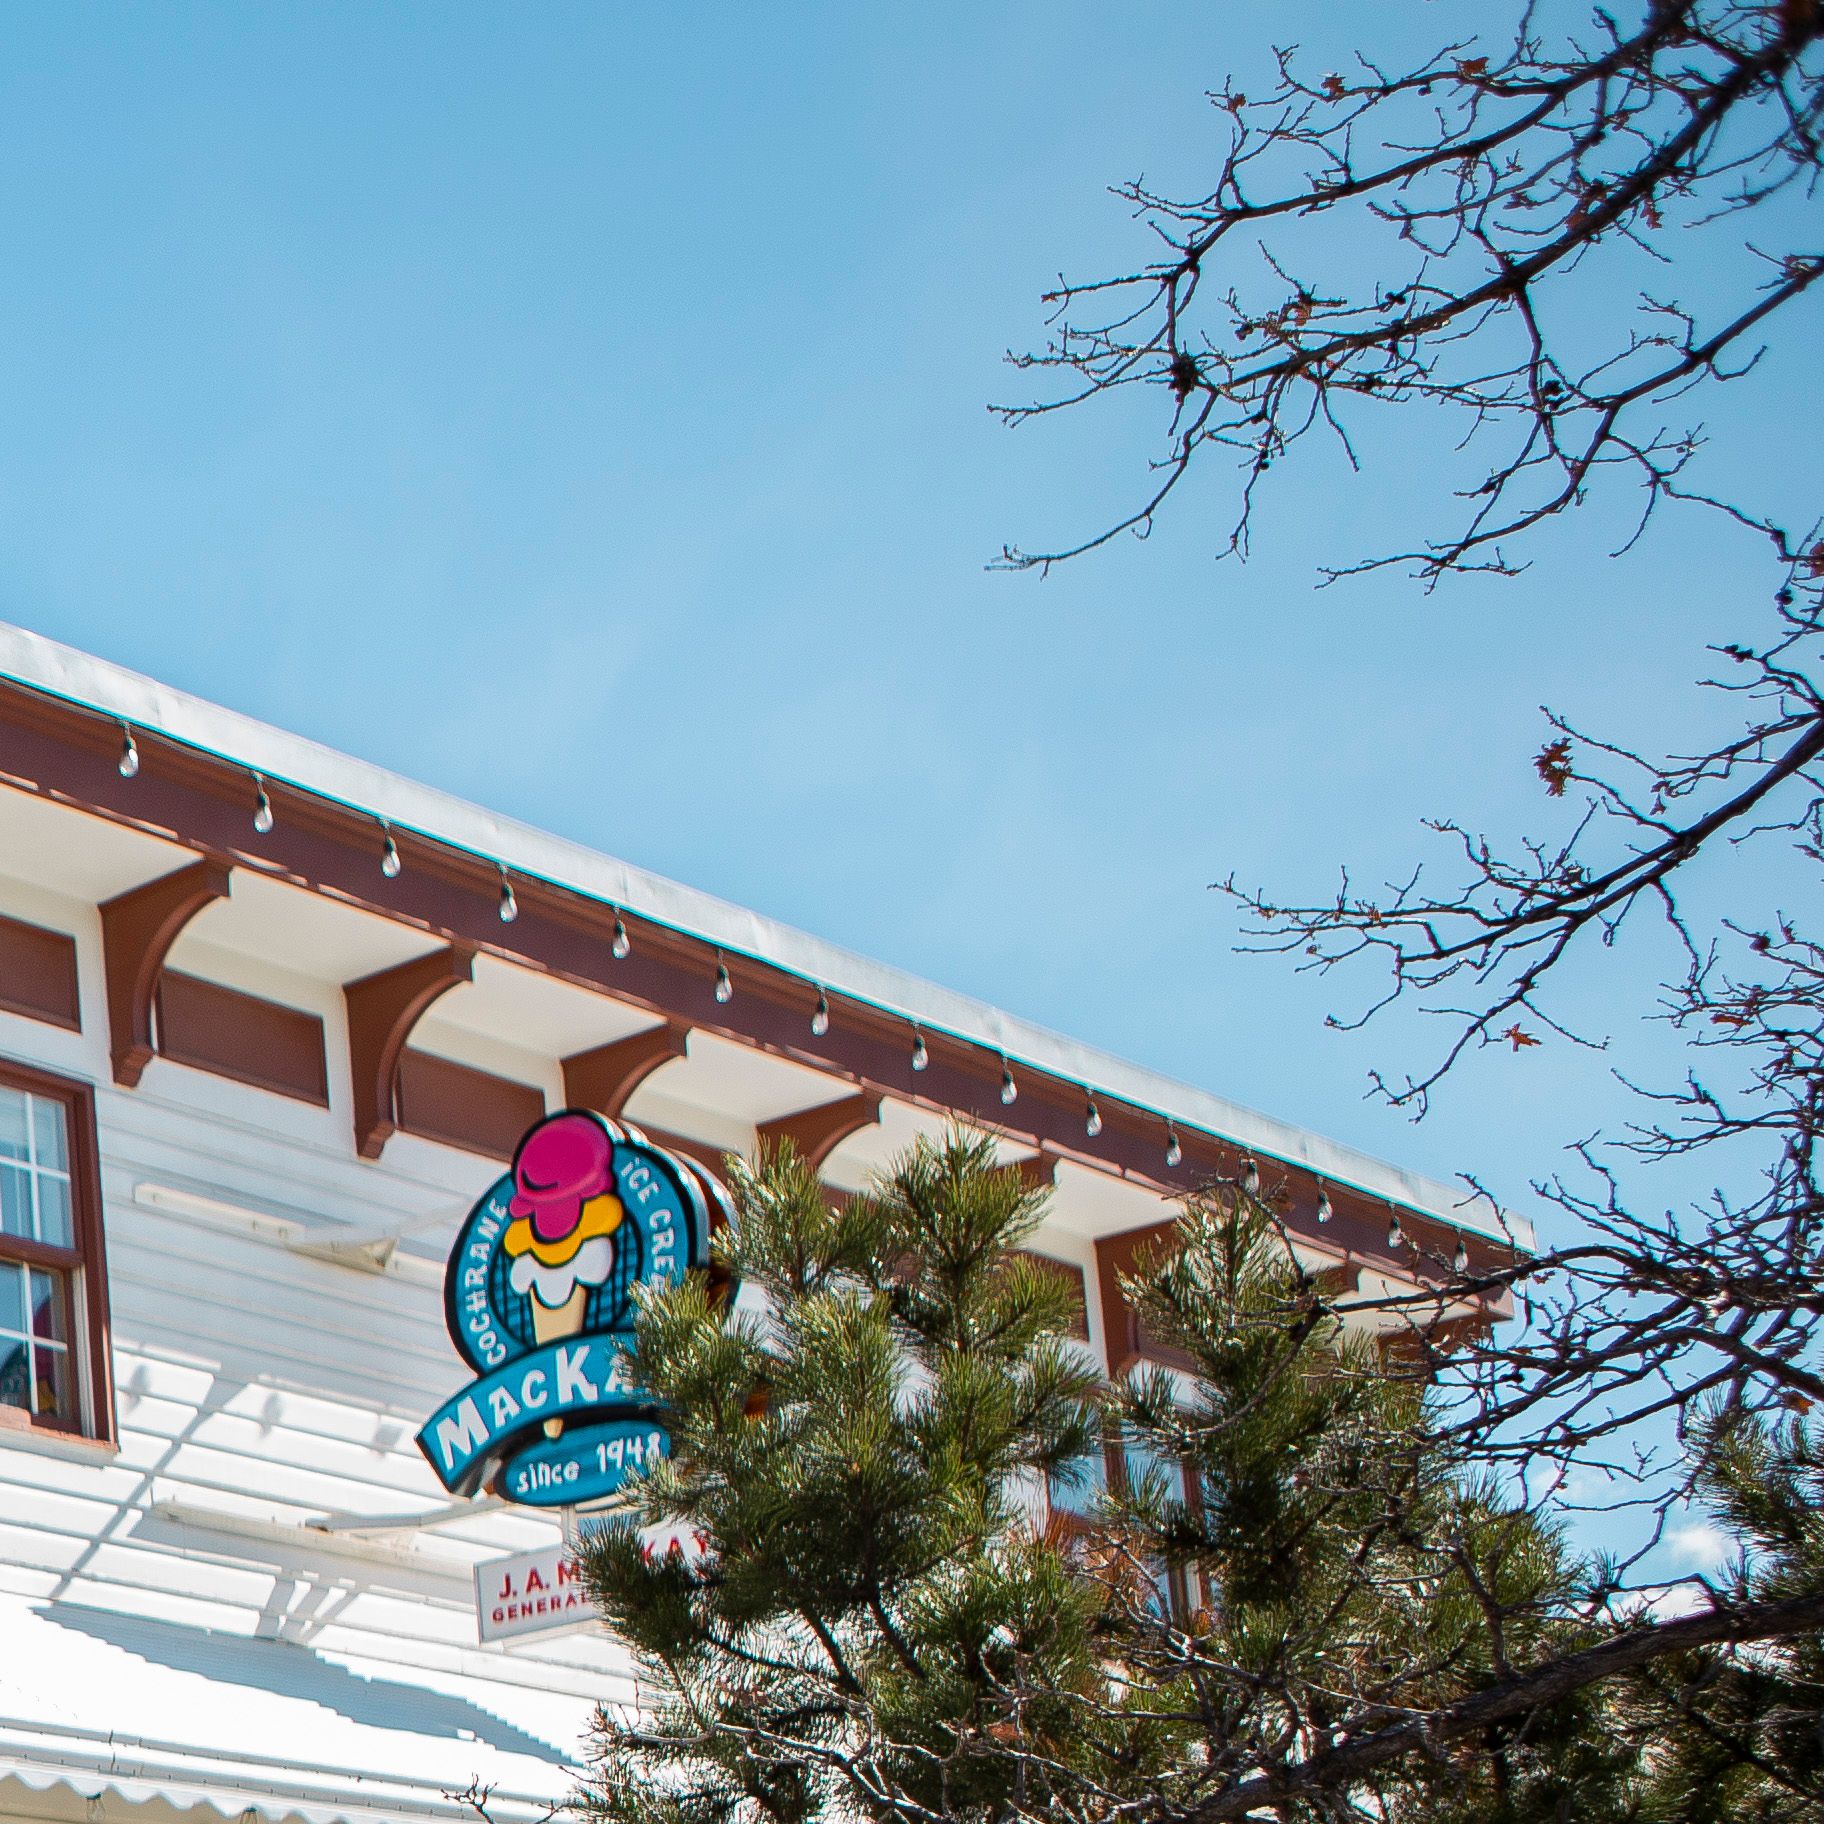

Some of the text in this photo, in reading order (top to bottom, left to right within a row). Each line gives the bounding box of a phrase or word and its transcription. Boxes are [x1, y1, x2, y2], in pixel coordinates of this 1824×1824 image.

[464, 1197, 509, 1366] COCHRANE
[648, 1208, 675, 1295] CREA
[516, 1430, 662, 1494] since 1948
[498, 1572, 518, 1600] J.
[525, 1566, 550, 1595] A.
